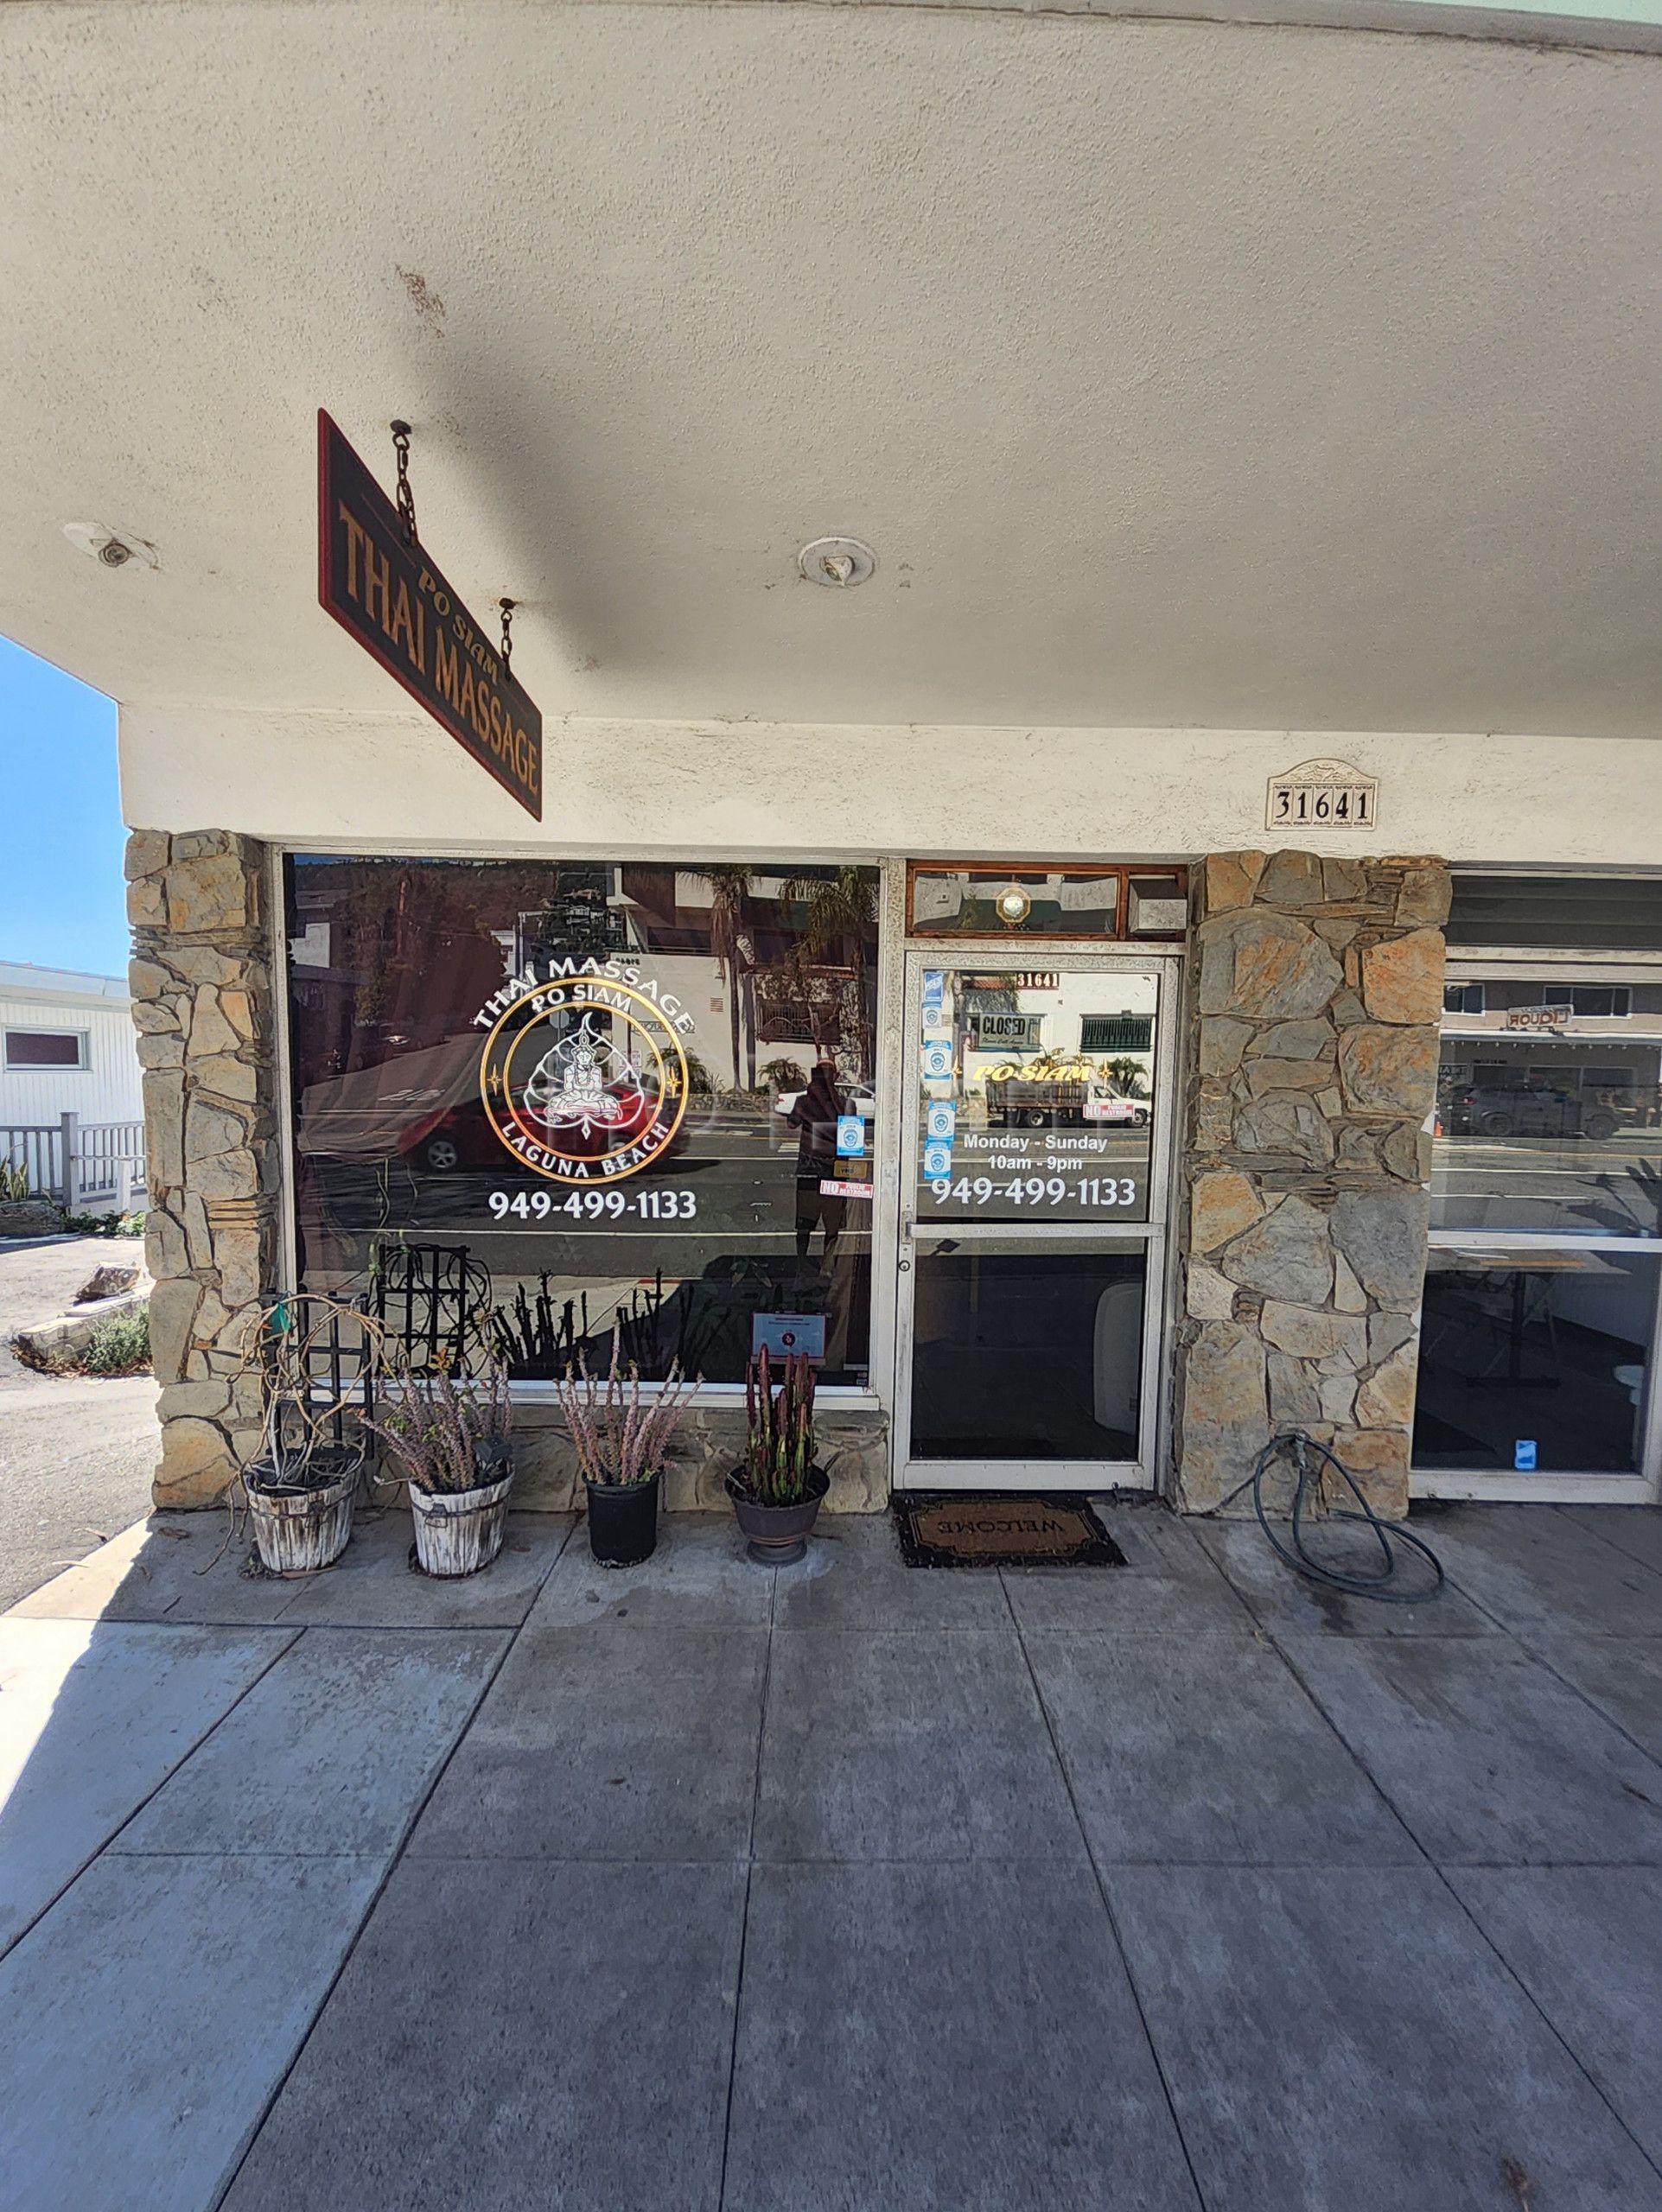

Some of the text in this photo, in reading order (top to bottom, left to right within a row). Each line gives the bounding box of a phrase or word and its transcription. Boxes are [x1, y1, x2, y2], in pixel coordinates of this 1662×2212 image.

[418, 566, 501, 686] PO SIAM
[339, 499, 538, 796] THAI MASSAGE
[1276, 791, 1367, 819] 31641
[1017, 973, 1058, 987] 31641
[474, 957, 695, 1035] THAI MASSAGE
[531, 984, 632, 1014] PO SIAM
[983, 1016, 1026, 1035] CLOSED
[972, 1065, 1090, 1082] PO SIAM
[502, 1122, 668, 1178] LAGUNA BEACH
[964, 1135, 1029, 1152] Monday
[1045, 1135, 1107, 1152] Sunday
[988, 1157, 1031, 1170] 10am
[1047, 1157, 1082, 1172] 9pm
[932, 1178, 1135, 1205] 949-499-1133
[488, 1192, 697, 1219] 949-499-1133
[937, 1520, 1065, 1535] WELCOME
